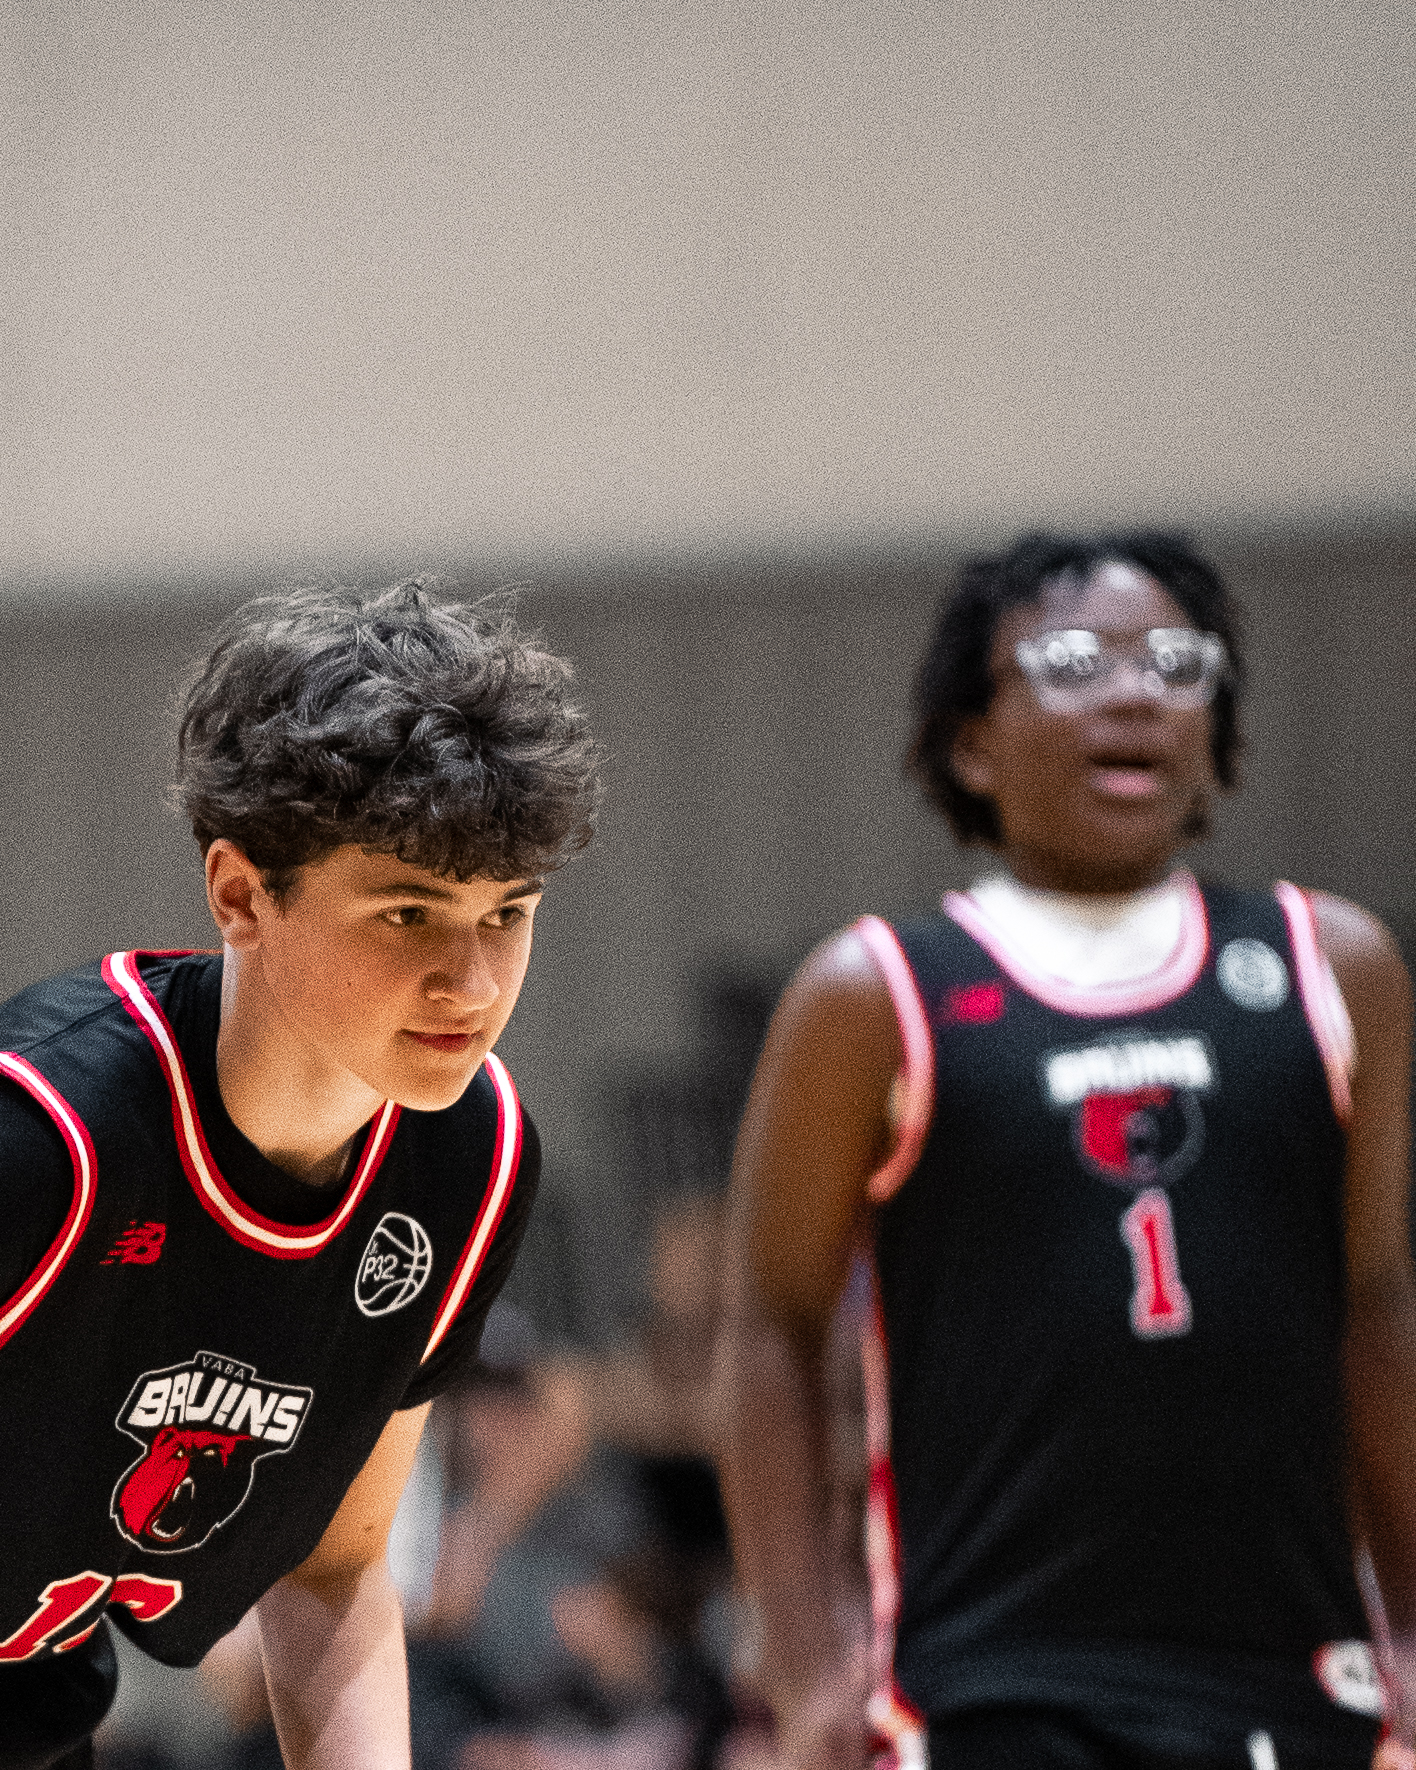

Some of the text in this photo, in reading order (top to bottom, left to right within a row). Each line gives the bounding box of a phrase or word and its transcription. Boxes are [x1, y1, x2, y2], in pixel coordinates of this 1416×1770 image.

[1120, 1187, 1192, 1338] 1
[201, 1355, 247, 1381] VABA
[127, 1371, 306, 1443] BRUINS
